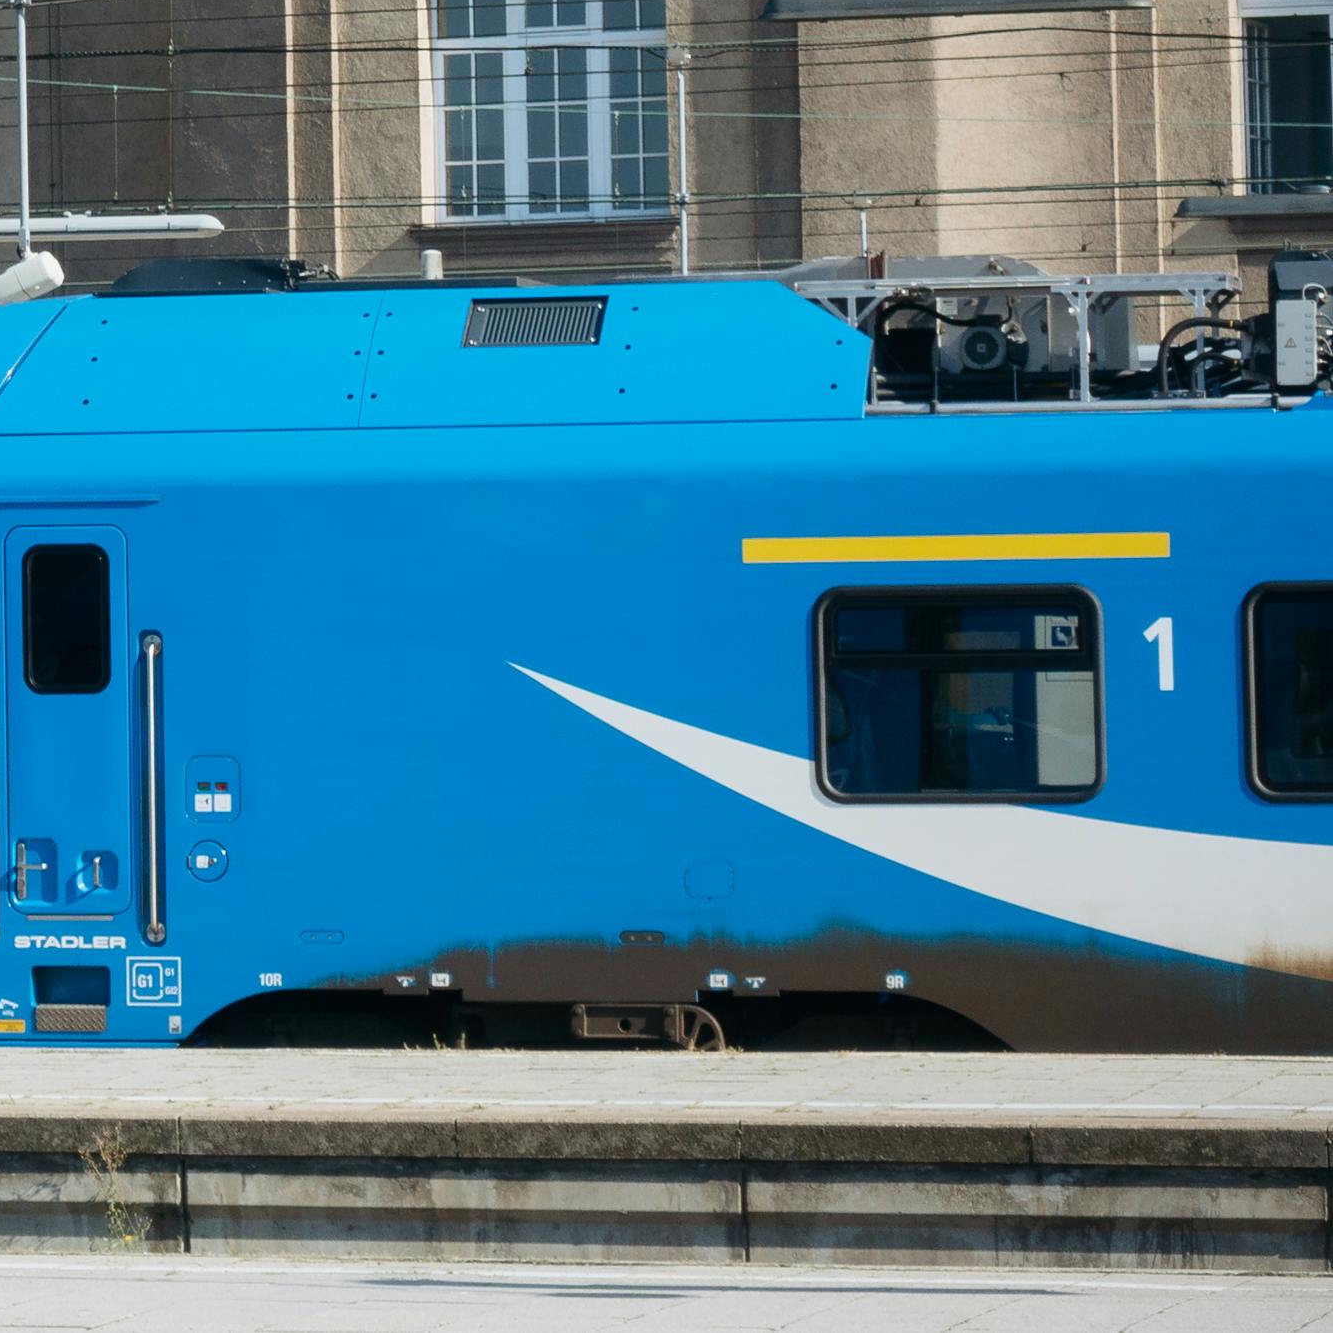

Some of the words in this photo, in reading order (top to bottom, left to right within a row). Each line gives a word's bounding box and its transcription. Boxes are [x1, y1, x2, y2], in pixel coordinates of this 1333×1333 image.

[1143, 616, 1174, 691] 1
[14, 935, 127, 949] STADLER
[137, 974, 153, 988] G1
[258, 973, 283, 987] 10R
[886, 975, 904, 989] 9R
